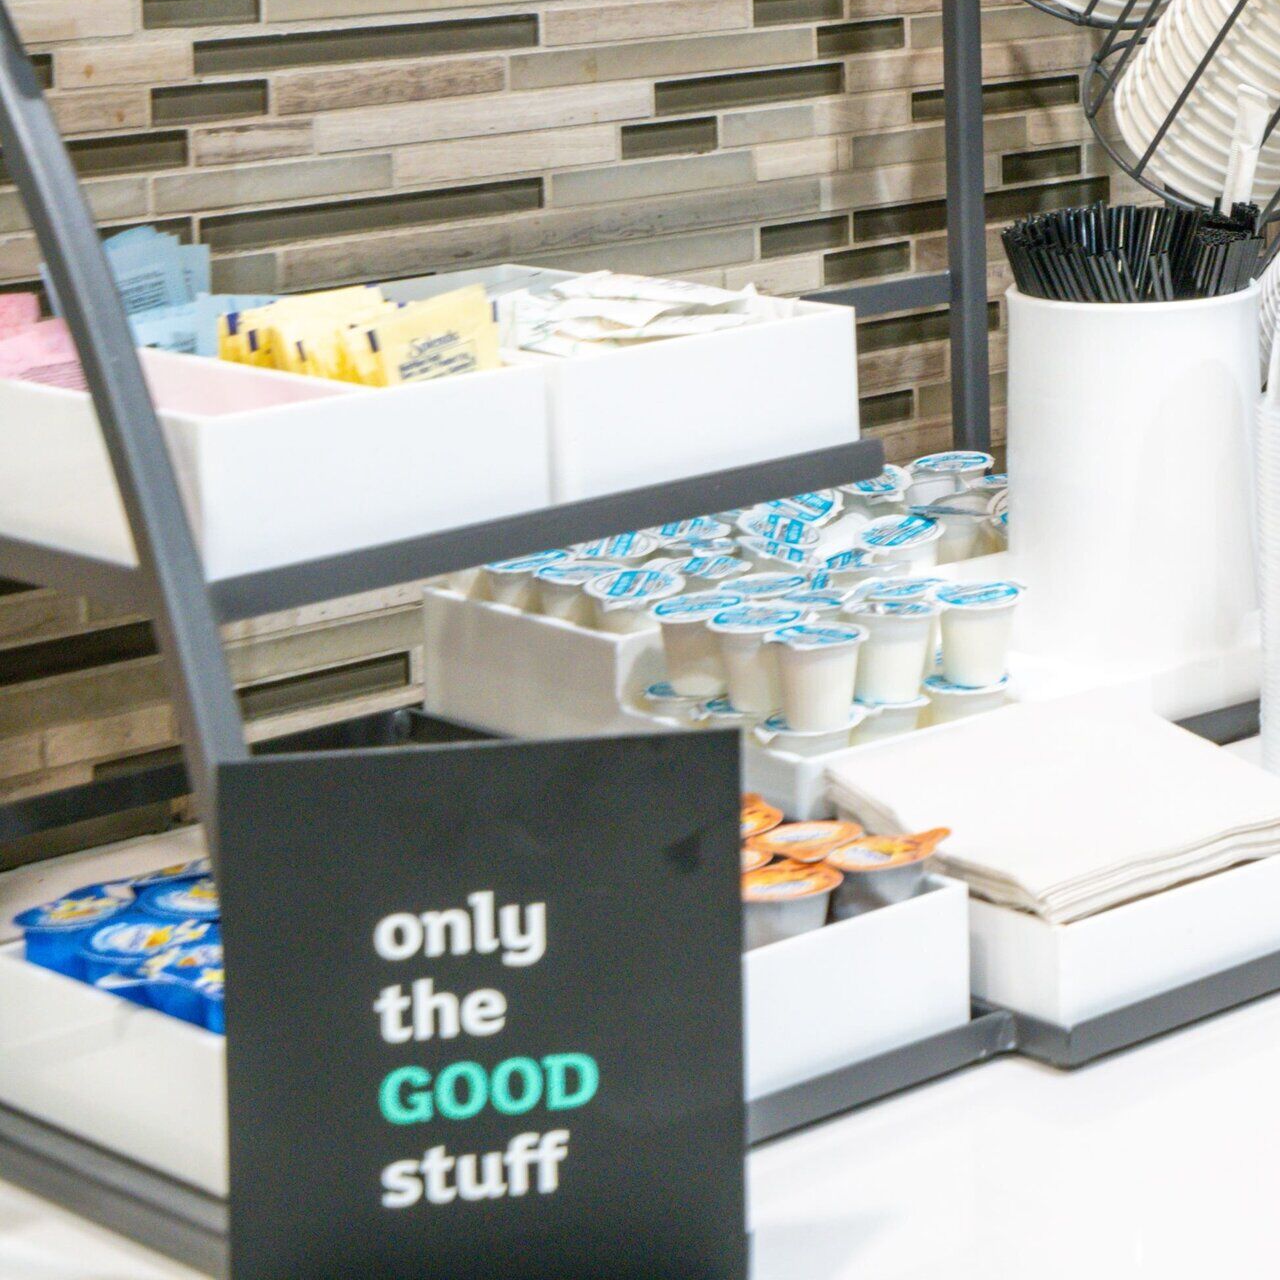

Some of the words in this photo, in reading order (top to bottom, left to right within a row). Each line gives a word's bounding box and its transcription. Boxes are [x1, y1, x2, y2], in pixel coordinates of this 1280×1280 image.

[373, 890, 547, 967] only
[373, 977, 508, 1044] the
[378, 1052, 600, 1126] GOOD
[381, 1129, 570, 1208] stuff
